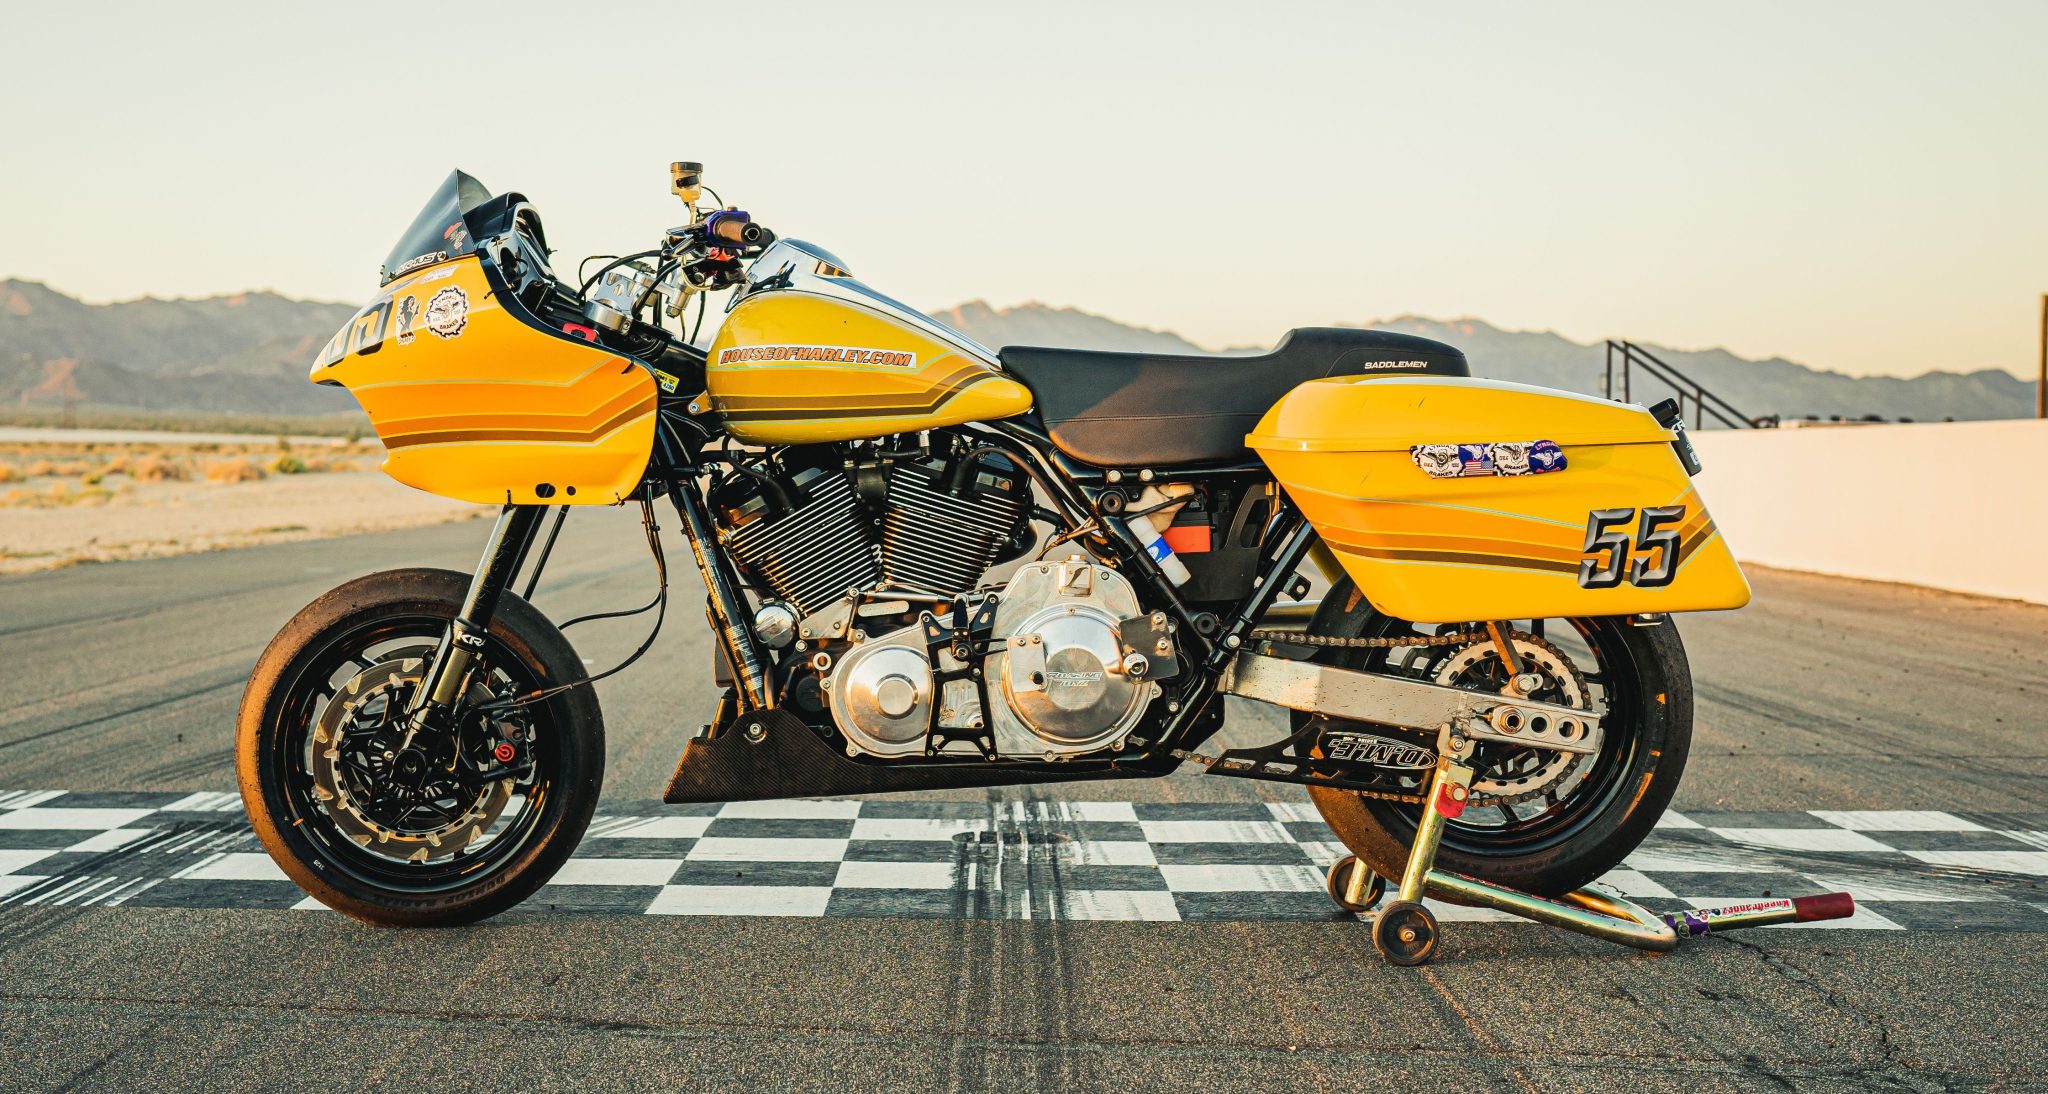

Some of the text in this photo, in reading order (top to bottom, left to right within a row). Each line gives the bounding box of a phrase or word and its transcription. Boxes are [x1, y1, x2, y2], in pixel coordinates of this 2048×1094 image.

[440, 319, 459, 330] BRAKES
[720, 345, 912, 367] HOUSEOFHARLEY.COM
[1364, 361, 1428, 370] SADDLEMEN
[1578, 505, 1687, 589] 55
